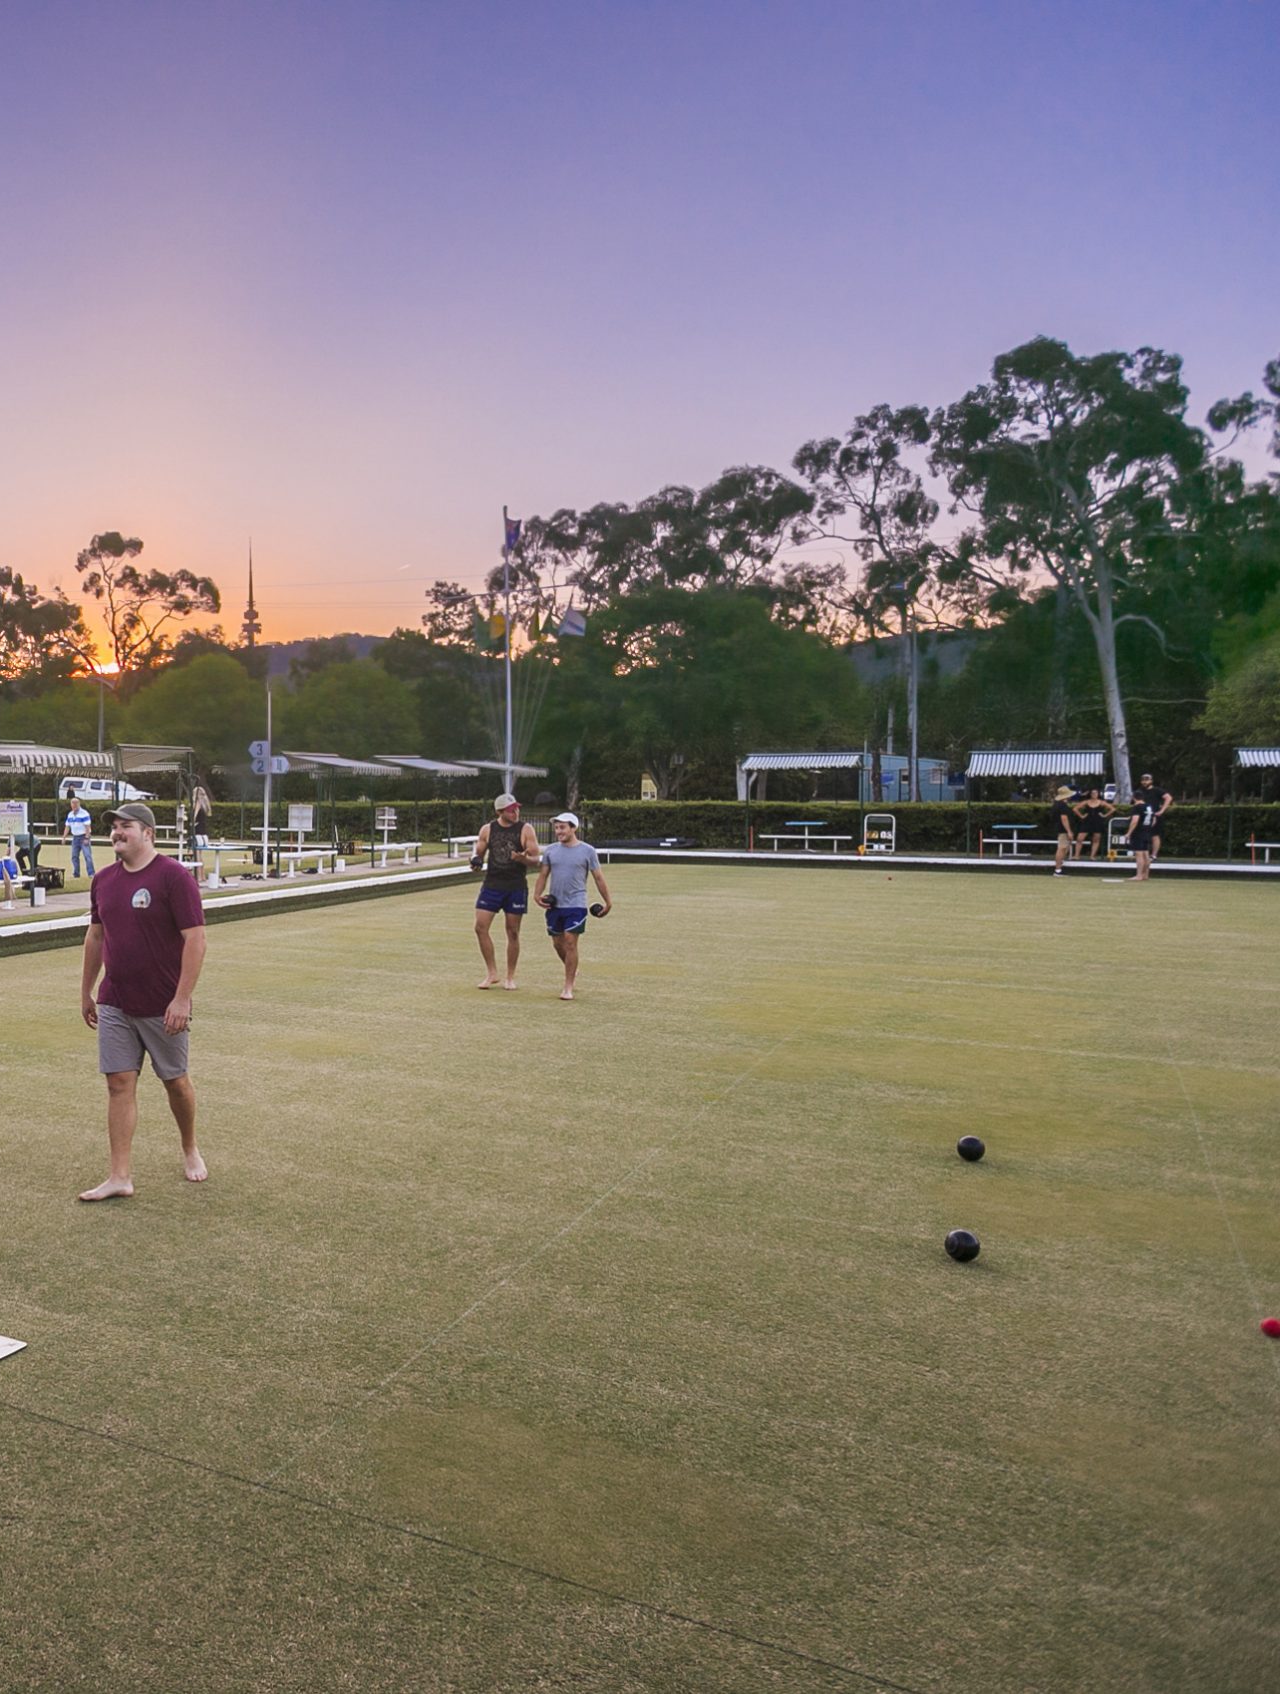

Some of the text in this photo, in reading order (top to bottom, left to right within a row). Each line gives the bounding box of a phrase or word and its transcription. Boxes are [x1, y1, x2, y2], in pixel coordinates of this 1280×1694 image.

[256, 743, 263, 756] 3
[257, 760, 264, 772] 2
[276, 759, 282, 771] 1
